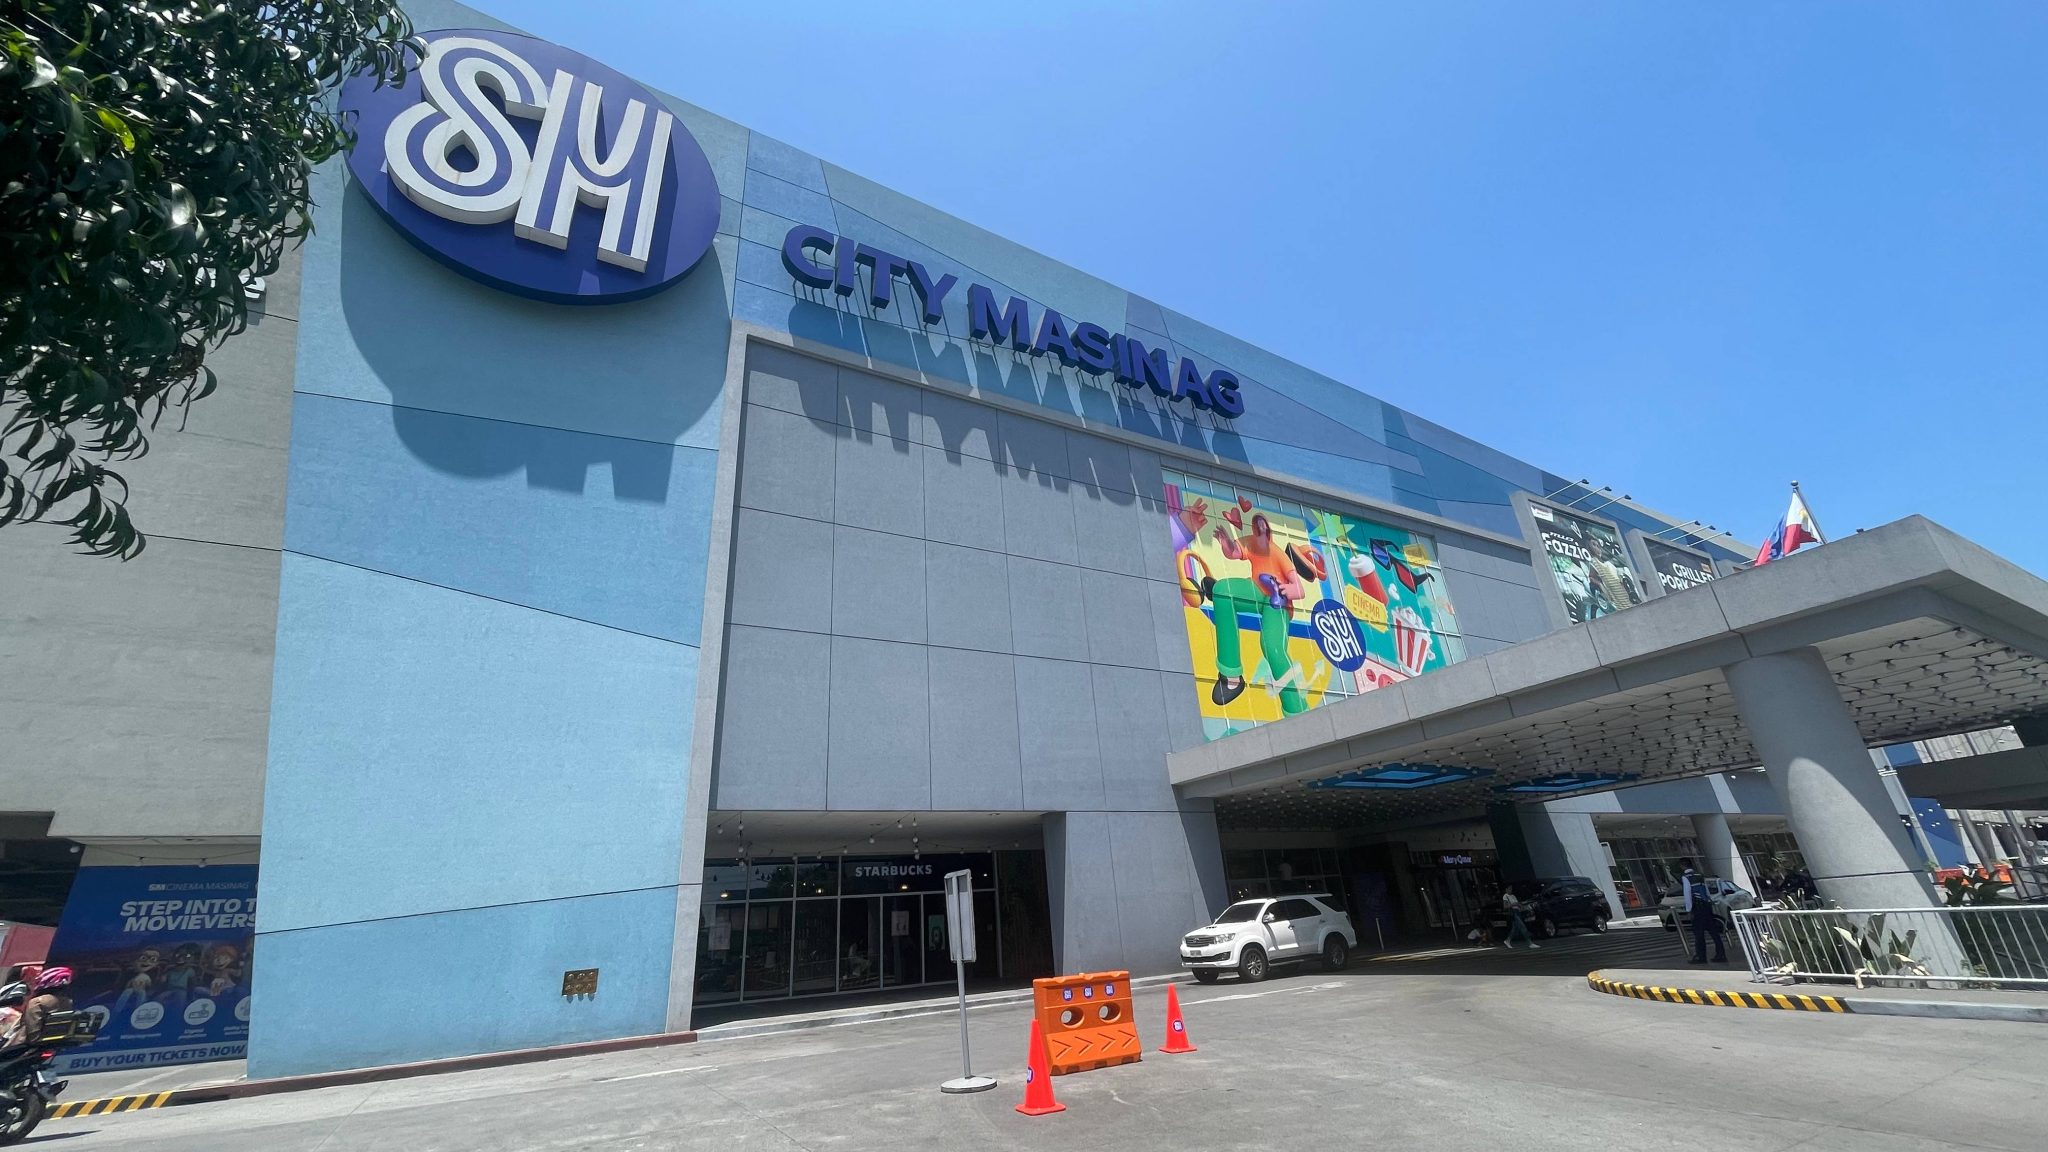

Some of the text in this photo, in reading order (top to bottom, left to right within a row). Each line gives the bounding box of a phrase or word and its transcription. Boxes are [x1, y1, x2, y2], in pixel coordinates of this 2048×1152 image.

[384, 37, 673, 273] SM
[781, 224, 1245, 419] CITY MASINAG
[1352, 592, 1380, 618] CINEMA
[1315, 608, 1363, 662] SM
[855, 864, 932, 877] STARBUCKS
[120, 901, 183, 916] STEP
[184, 899, 240, 914] INTO
[70, 1044, 246, 1069] BUY YOUR TICKETS NOW
